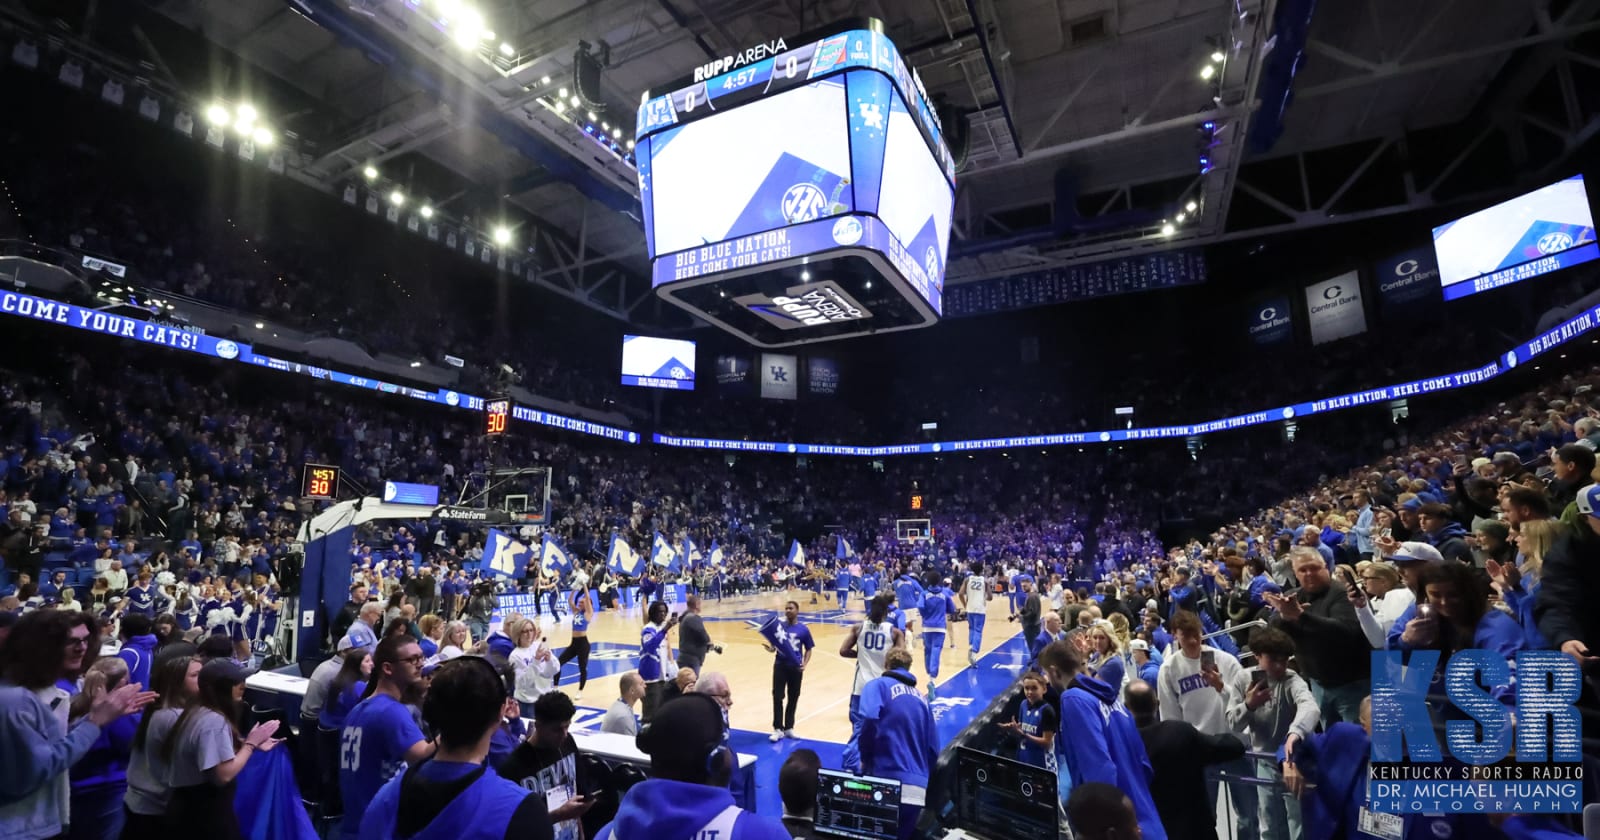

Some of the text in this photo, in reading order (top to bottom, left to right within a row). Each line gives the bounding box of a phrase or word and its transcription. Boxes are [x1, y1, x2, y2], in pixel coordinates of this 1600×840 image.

[694, 56, 733, 83] RUPP
[734, 37, 788, 68] ARENA
[786, 56, 797, 79] 0
[723, 68, 756, 90] 4:57
[685, 91, 695, 113] 0
[676, 229, 791, 268] BIG BLUE NATION,
[675, 244, 791, 280] HERE COME YOUR CATS!
[1380, 269, 1438, 292] Central Bank
[1474, 275, 1490, 287] BIG
[1492, 268, 1516, 281] BLUE
[1311, 294, 1358, 314] Central Bank
[2, 293, 70, 323] COME
[79, 309, 136, 337] YOUR
[143, 324, 198, 350] CATS!
[1250, 317, 1290, 334] Central Bank
[1529, 339, 1542, 356] BIG
[1541, 329, 1561, 350] BLUE
[1560, 313, 1595, 340] NATION,
[349, 376, 367, 387] 4:57
[770, 366, 788, 382] UK
[1312, 401, 1326, 412] BIG
[1328, 397, 1350, 409] BLUE
[1352, 389, 1390, 405] NATION,
[1393, 383, 1420, 397] HERE
[1422, 377, 1451, 392] COME
[1455, 369, 1485, 385] YOUR
[487, 412, 505, 432] 30
[546, 412, 566, 428] HERE
[567, 417, 586, 433] COME
[313, 469, 334, 480] 4:57
[311, 480, 329, 495] 30
[490, 534, 528, 576] K
[971, 581, 982, 590] 22
[500, 595, 514, 607] BIG
[864, 631, 886, 651] 00
[1178, 673, 1209, 695] KENTU
[341, 726, 363, 772] 23
